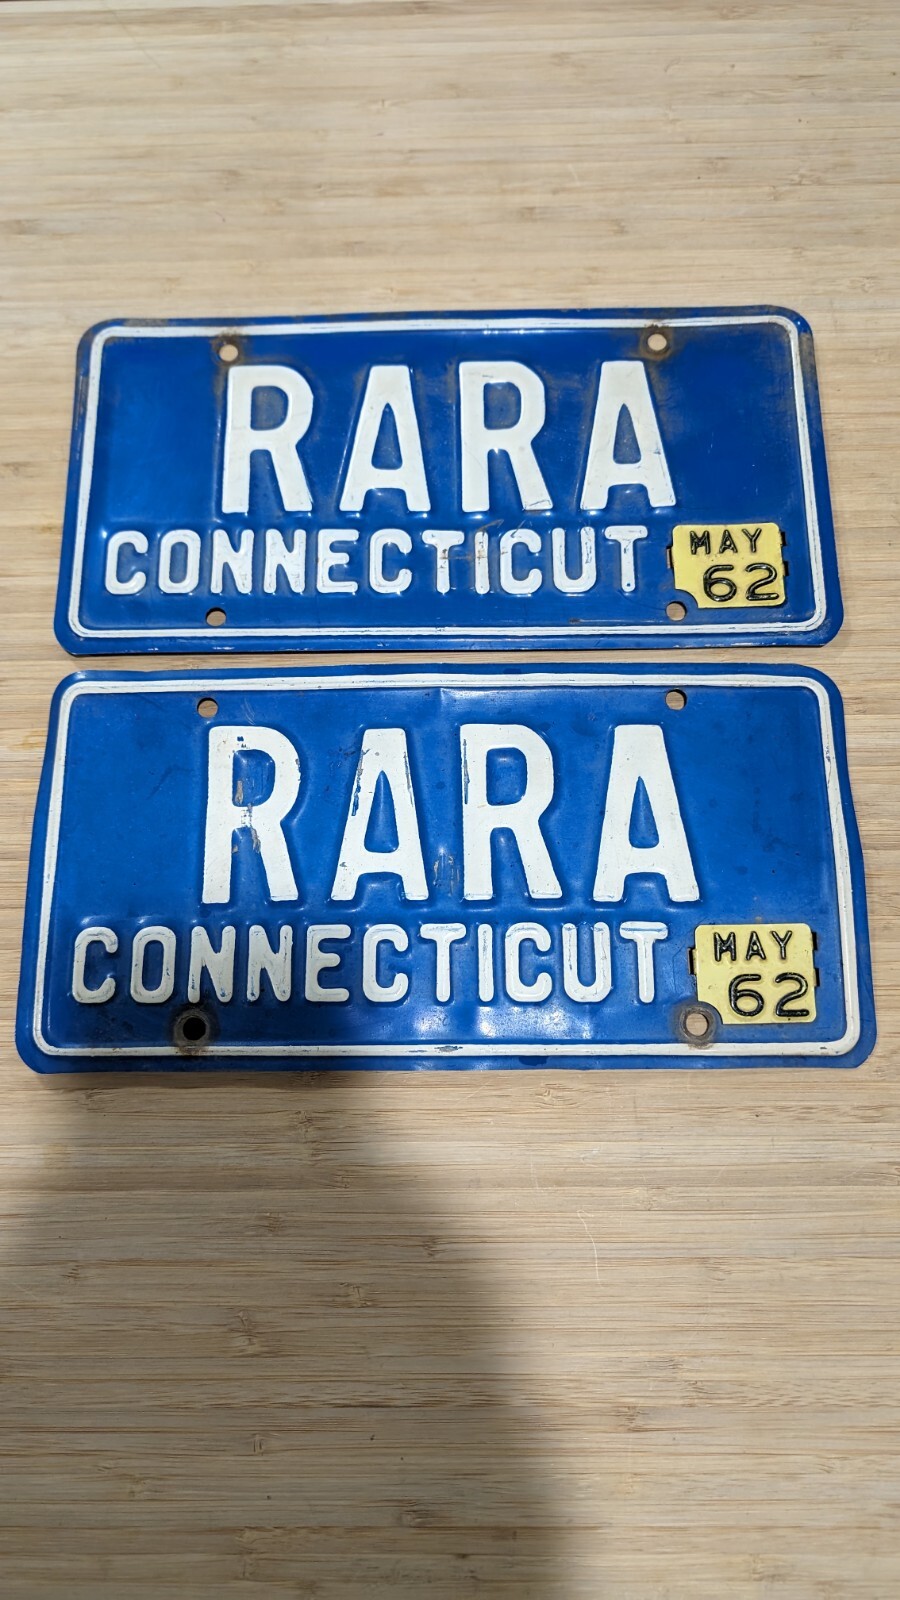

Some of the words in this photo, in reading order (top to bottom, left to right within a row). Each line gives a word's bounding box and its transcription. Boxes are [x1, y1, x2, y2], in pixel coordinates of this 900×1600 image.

[221, 360, 677, 514] RARA
[104, 525, 648, 596] CONNECTICUT
[689, 528, 762, 555] MAY
[703, 562, 780, 602] 62
[202, 723, 700, 905] RARA
[71, 921, 669, 1005] CONNECTICUT
[713, 930, 793, 962] MAY
[728, 972, 810, 1017] 62
